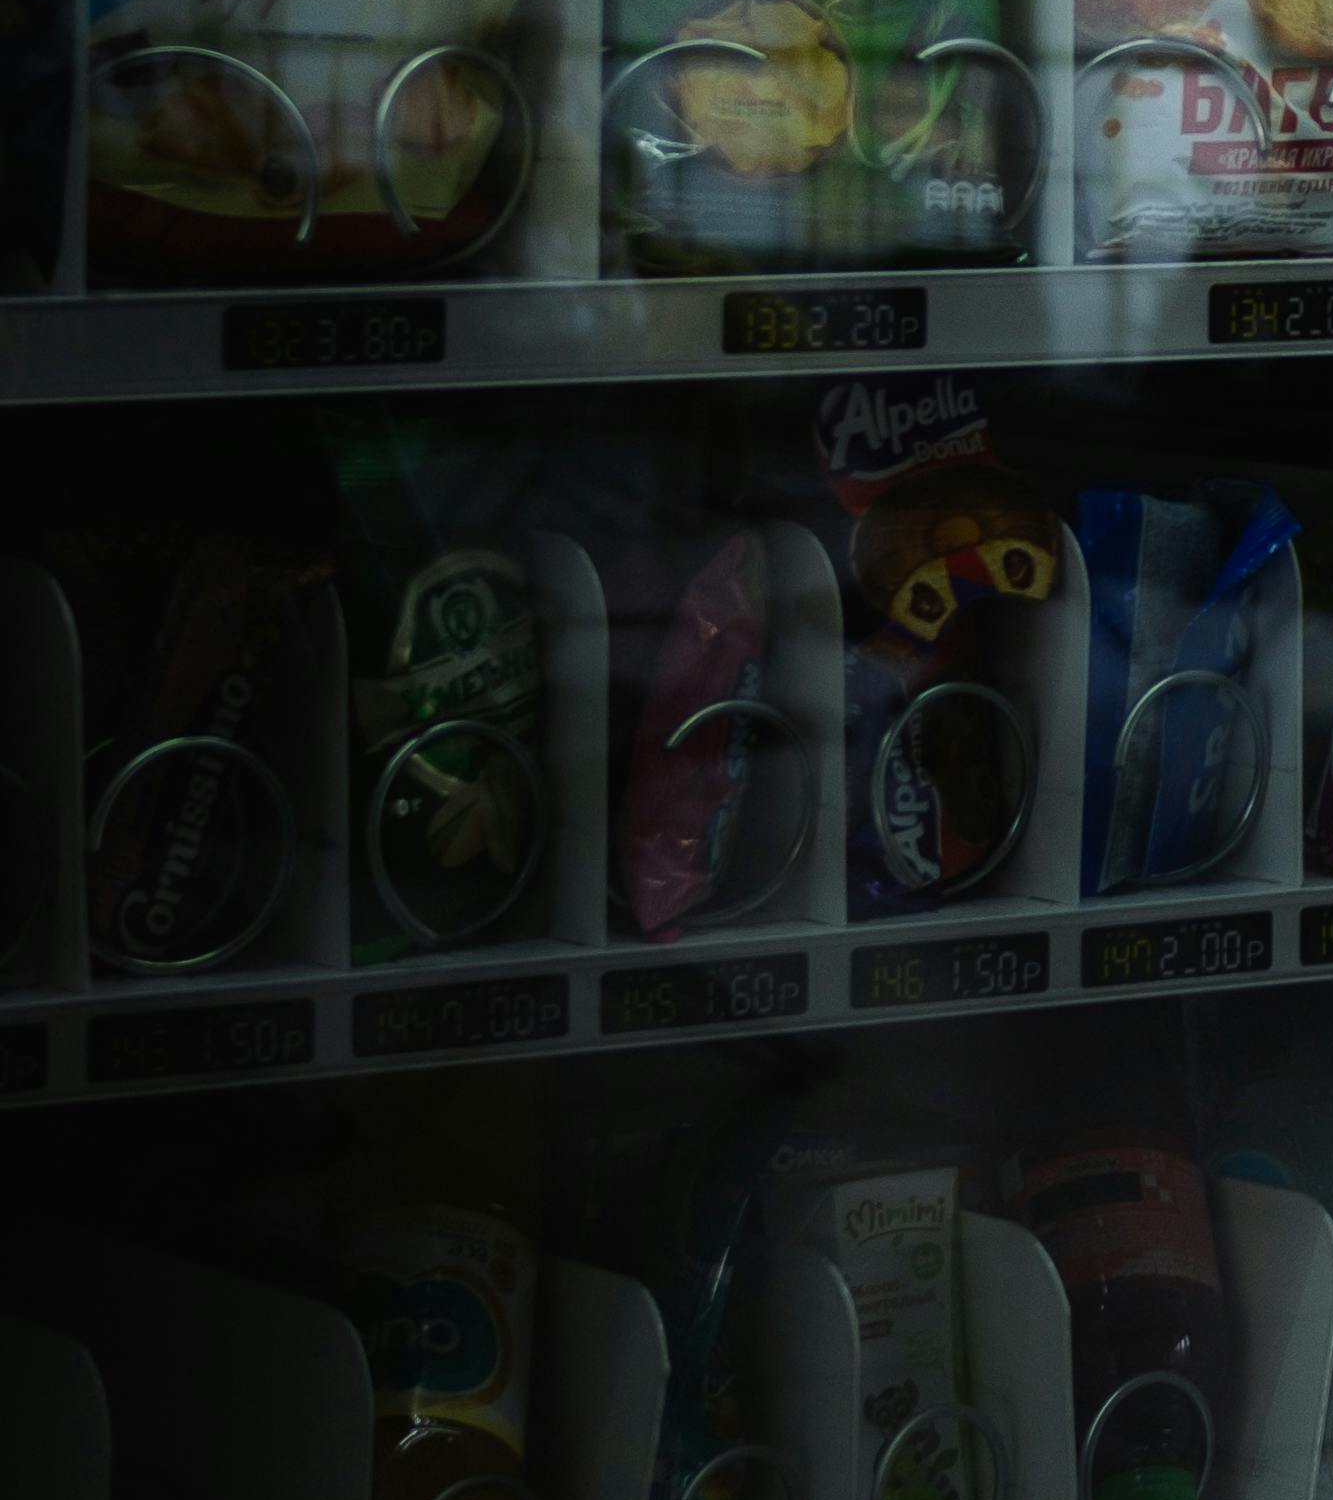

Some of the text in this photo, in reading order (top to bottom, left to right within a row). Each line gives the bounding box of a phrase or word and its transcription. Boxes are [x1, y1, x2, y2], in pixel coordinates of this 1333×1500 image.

[830, 375, 978, 470] Alpella
[912, 428, 988, 464] Donut
[842, 1195, 947, 1242] Mimimi
